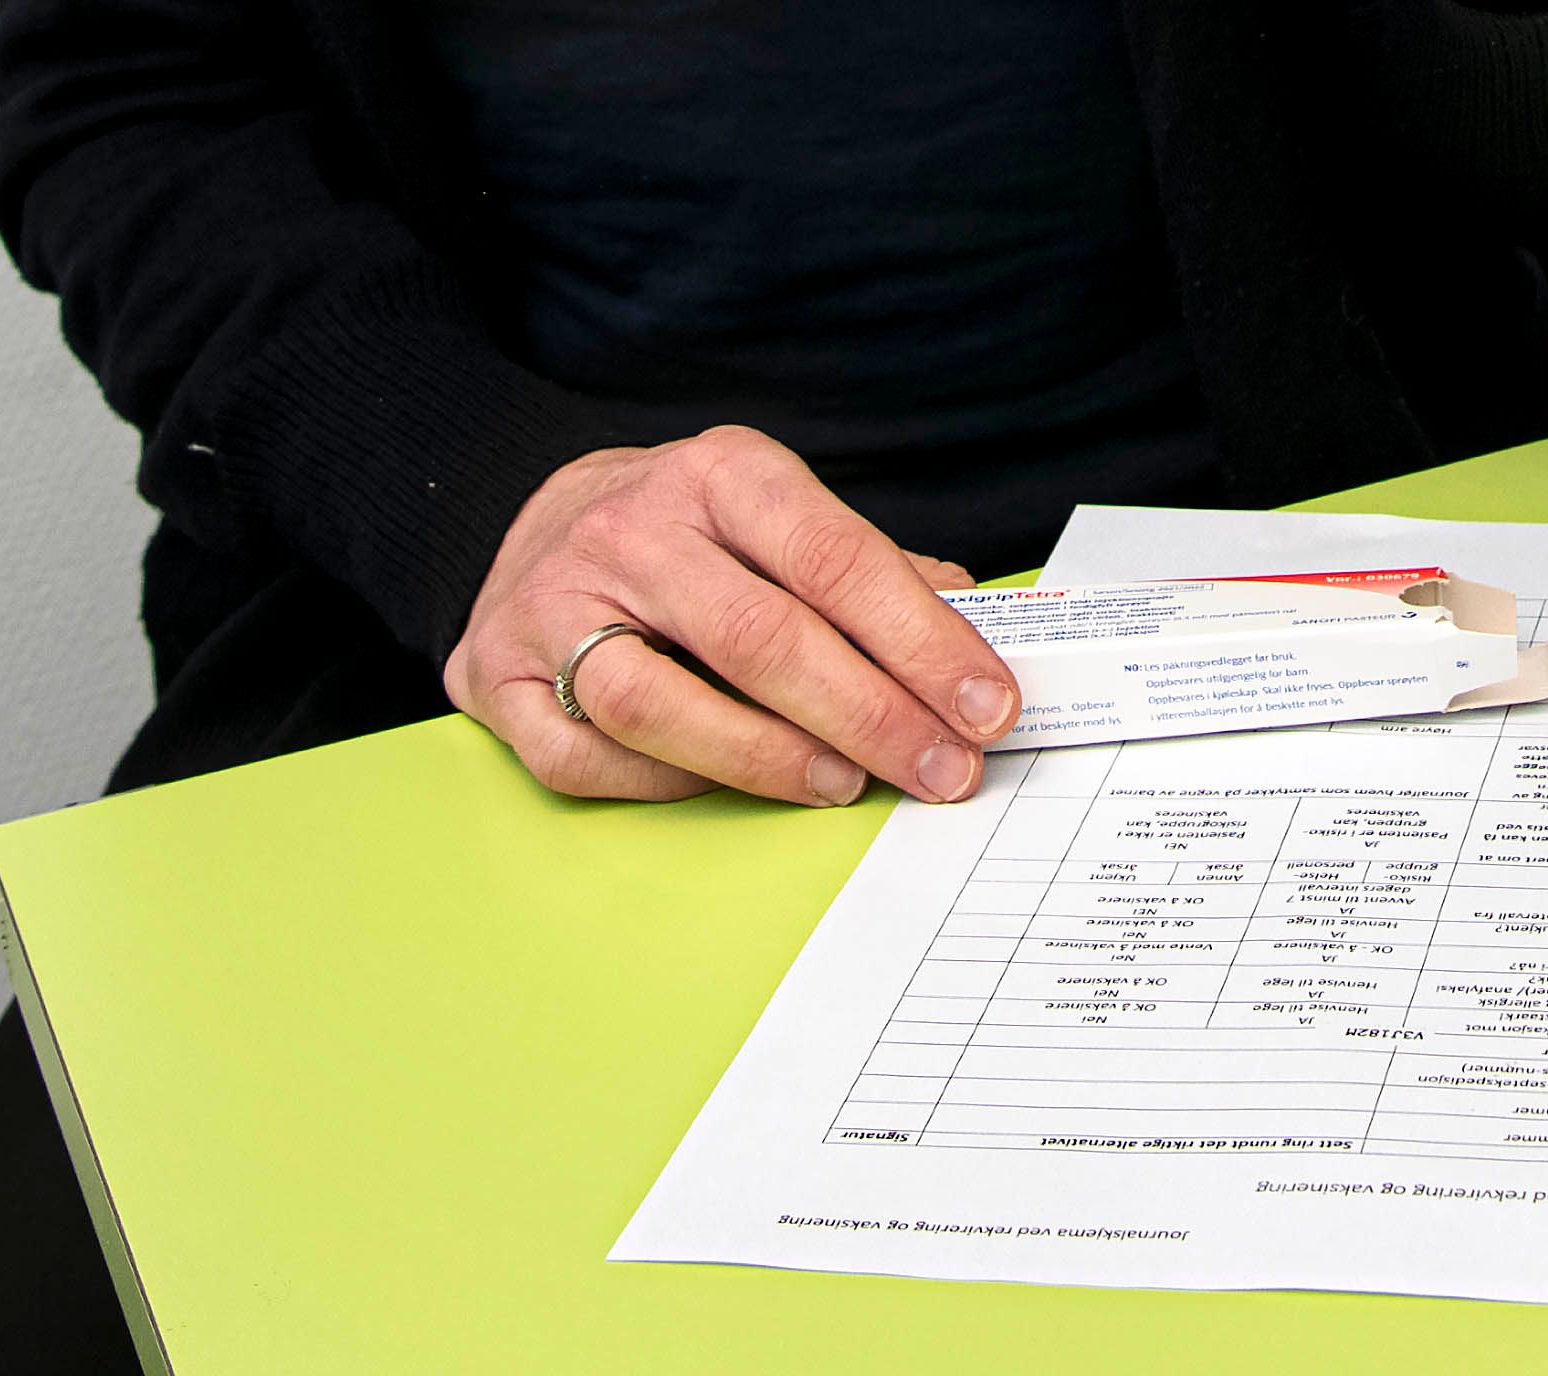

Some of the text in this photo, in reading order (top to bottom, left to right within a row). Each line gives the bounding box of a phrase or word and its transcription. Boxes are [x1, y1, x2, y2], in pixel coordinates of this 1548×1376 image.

[946, 590, 1065, 604] axigripTetra
[1292, 618, 1340, 626] SANOFI
[1124, 664, 1142, 672] NO:
[1144, 663, 1159, 672] Les
[1163, 655, 1252, 673] pakningsvedlegget
[1255, 654, 1270, 664] før
[1146, 675, 1204, 689] Oppbevares
[1206, 670, 1266, 685] utilgjengelig
[1269, 669, 1283, 678] for
[1149, 691, 1205, 705] Oppbevares
[1262, 686, 1282, 695] Skal
[1284, 684, 1304, 693] ikke
[1338, 678, 1384, 691] Oppbevar
[1387, 675, 1428, 687] sprøyten
[1022, 701, 1115, 716] edfryses. Opbevar
[1156, 706, 1237, 722] ytteremballasjen
[1240, 704, 1254, 714] for
[1266, 700, 1306, 712] beskytte
[1308, 698, 1328, 706] mot
[1028, 723, 1038, 732] at
[1041, 720, 1080, 732] beskytte
[1083, 717, 1105, 727] mod
[1196, 874, 1243, 884] Annen
[1056, 978, 1167, 987] OK å vaksinere
[1262, 977, 1377, 989] Henvise til lege
[1093, 990, 1119, 999] Nei
[1308, 991, 1324, 1000] JA
[1465, 1024, 1496, 1034] mot
[1344, 1030, 1423, 1042] V3J182M
[839, 1130, 910, 1143] Signatur
[1040, 1137, 1353, 1150] Sett ring rundt det riktige alternativet
[1254, 1180, 1373, 1199] vaksinering
[1379, 1184, 1406, 1196] og
[1411, 1185, 1526, 1204] rekvirering
[777, 1214, 1189, 1242] Journalskjema ved rekvirering og vaksinering
